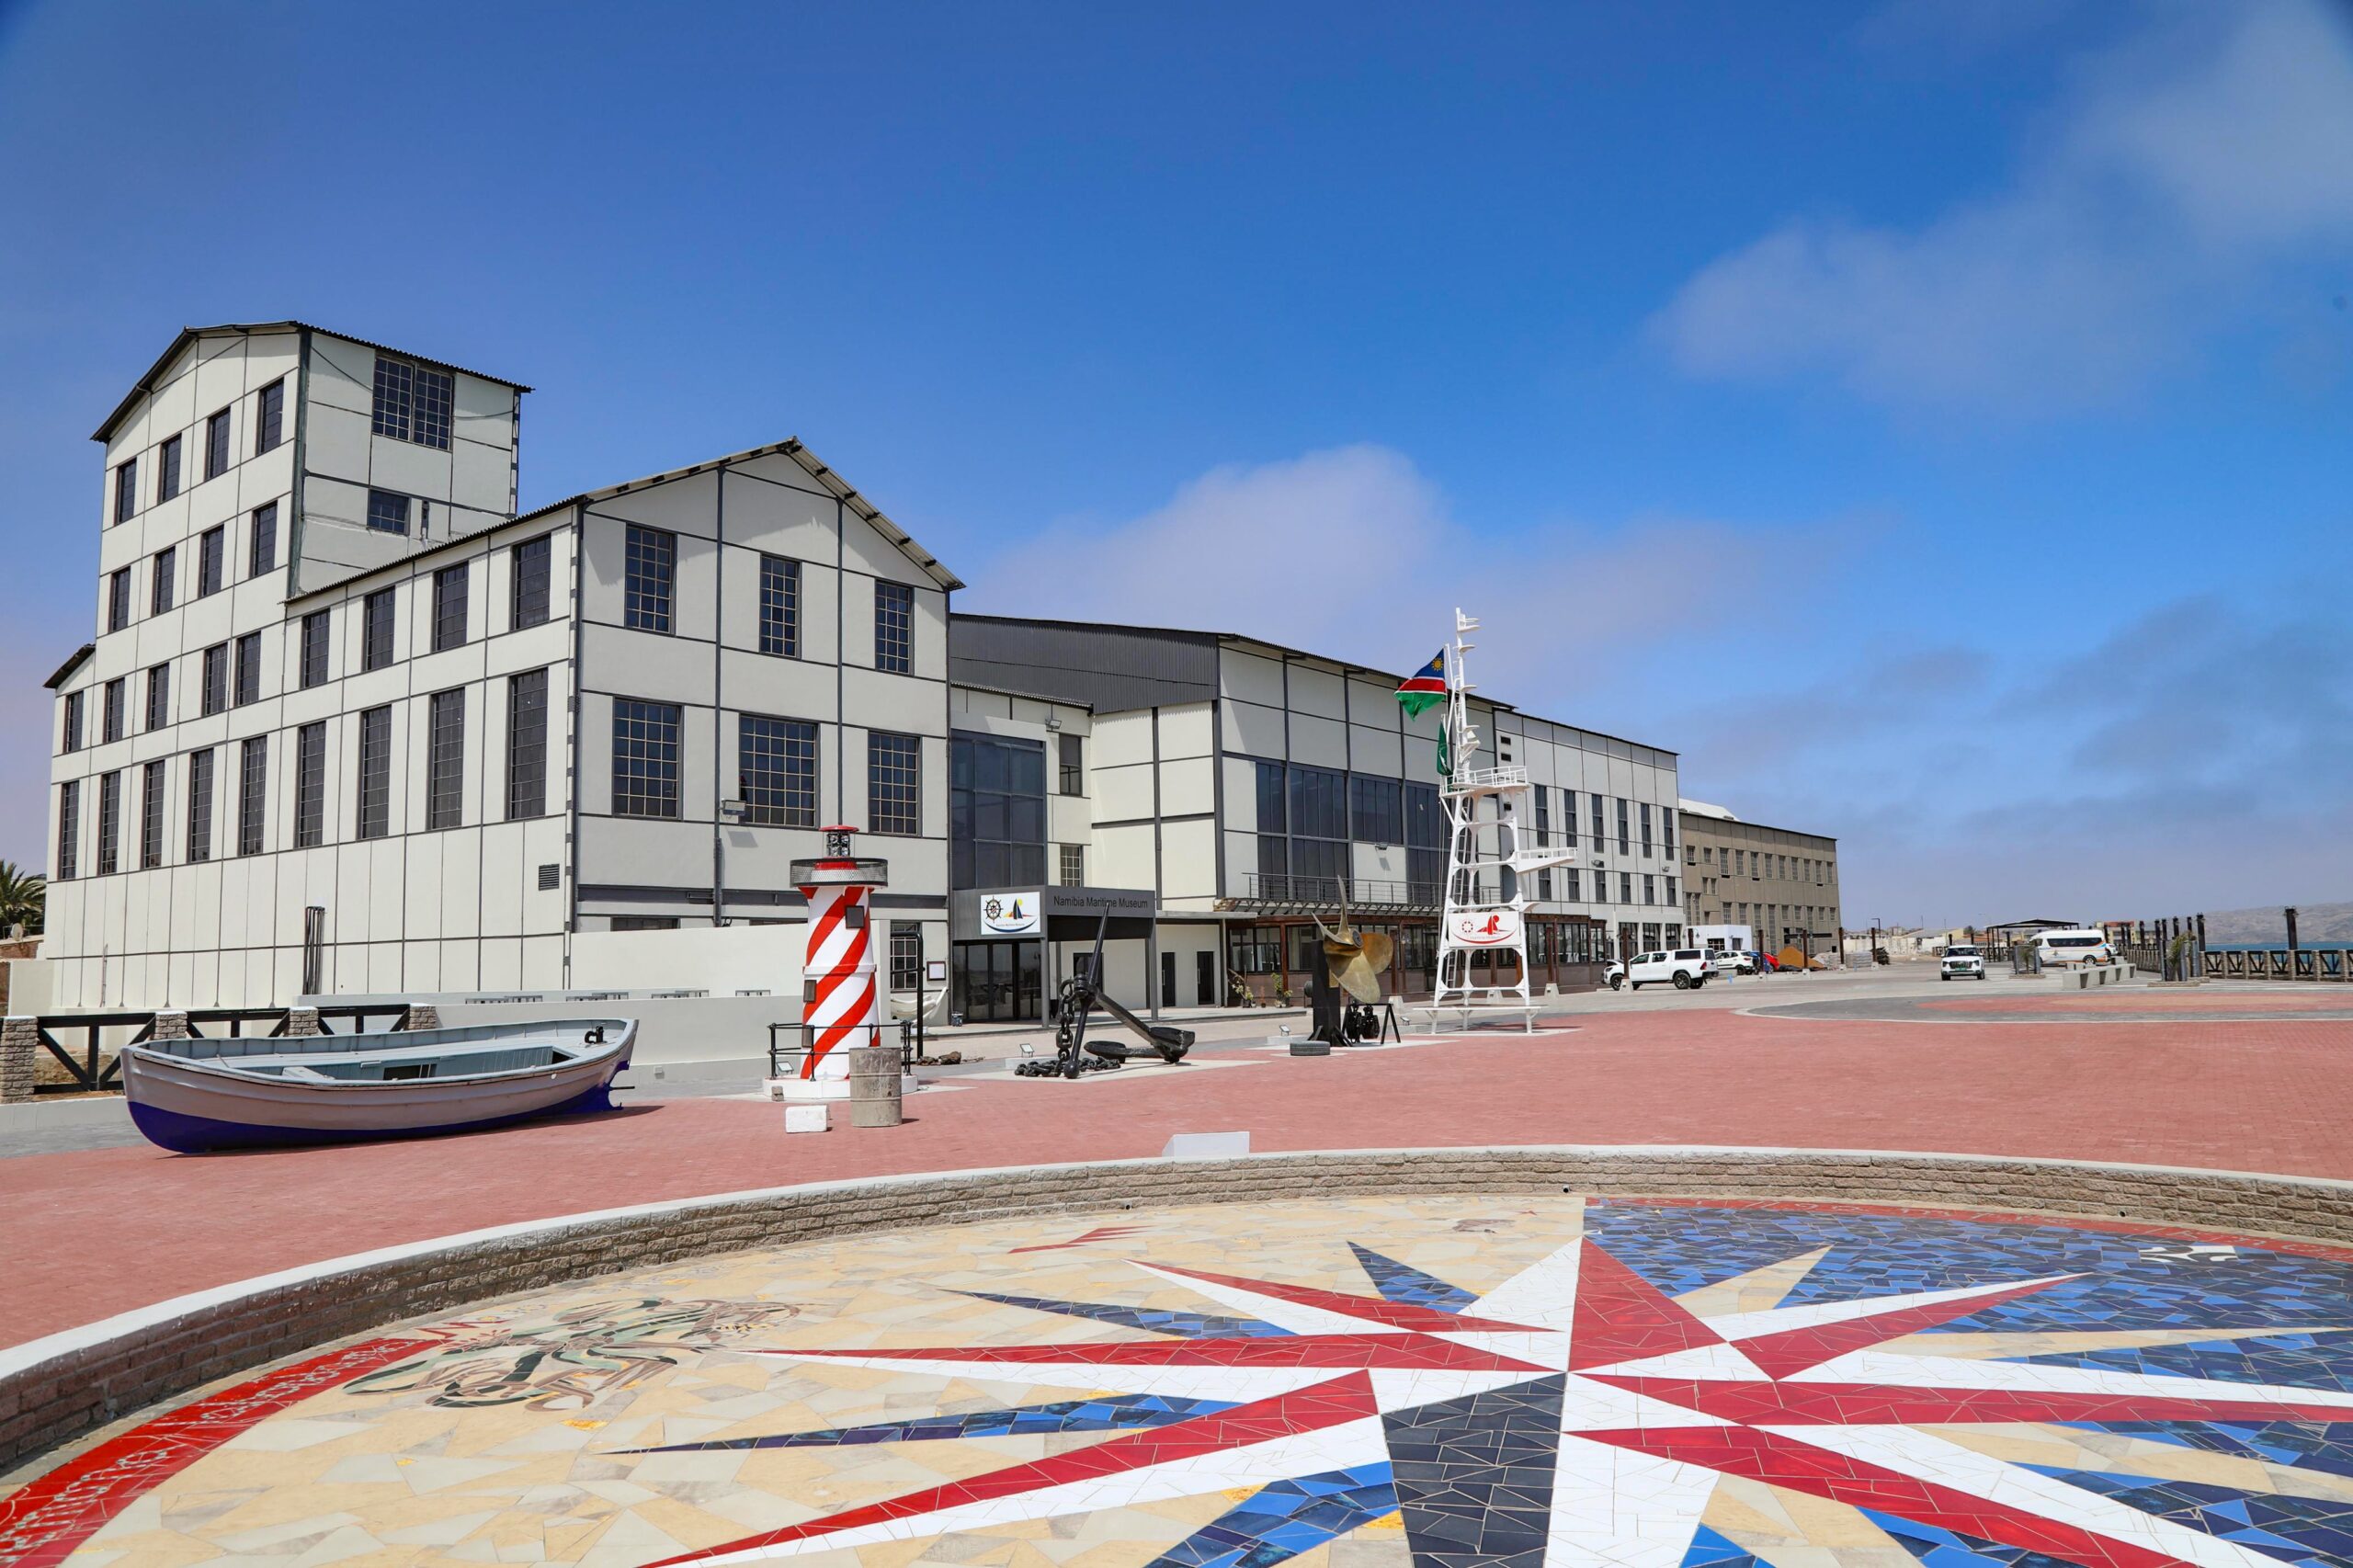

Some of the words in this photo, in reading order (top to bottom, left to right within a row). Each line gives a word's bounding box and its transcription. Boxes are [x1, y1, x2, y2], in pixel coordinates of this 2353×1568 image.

[1053, 895, 1085, 907] Namibia
[1086, 896, 1117, 908] Maritime
[1119, 897, 1148, 909] Museum
